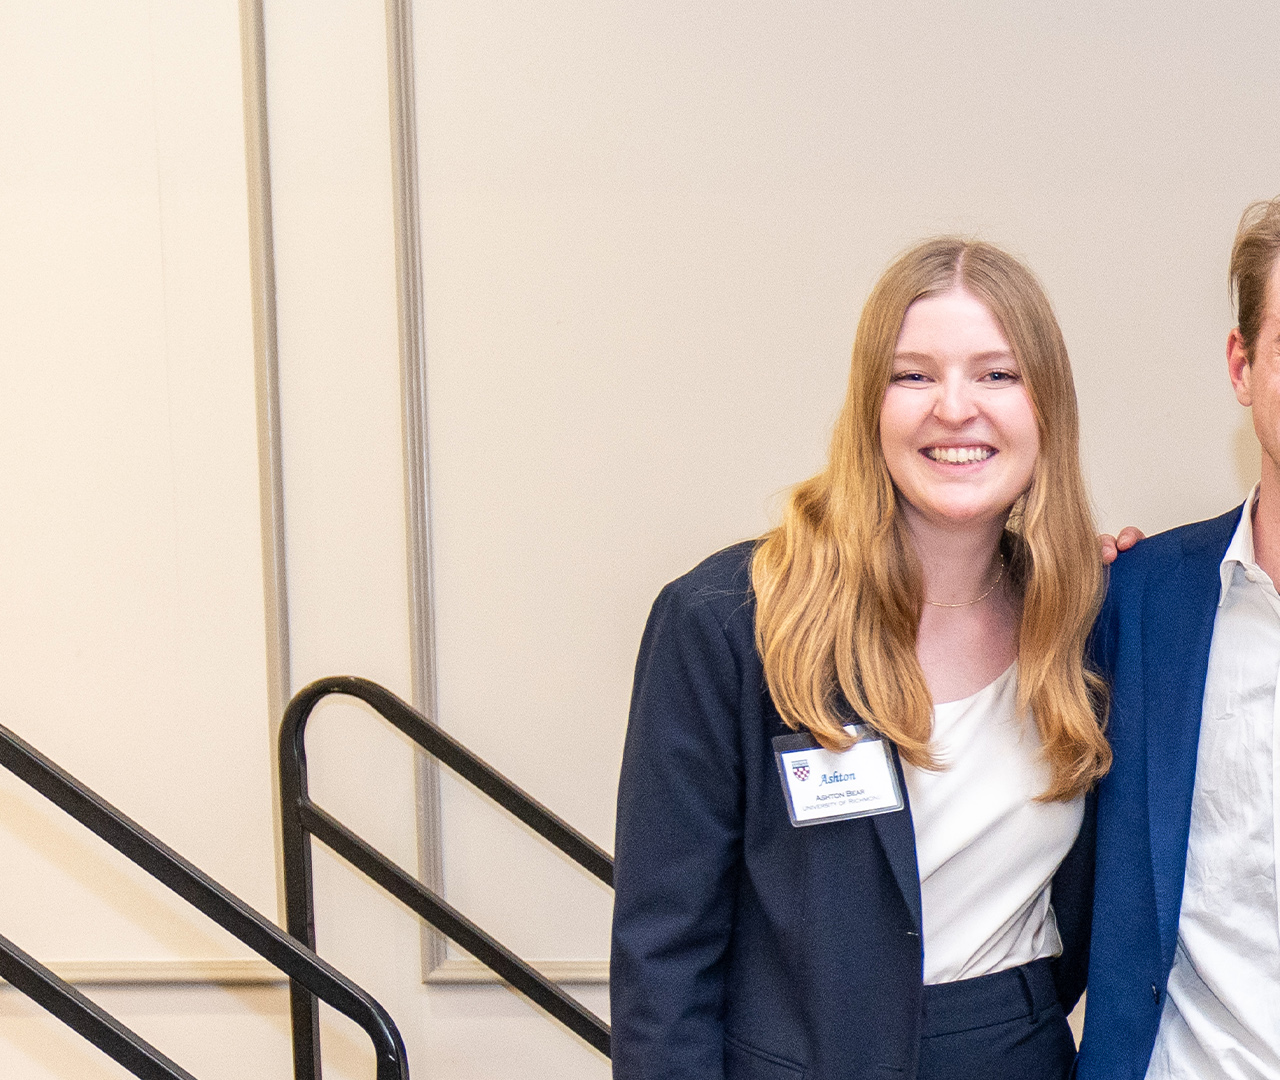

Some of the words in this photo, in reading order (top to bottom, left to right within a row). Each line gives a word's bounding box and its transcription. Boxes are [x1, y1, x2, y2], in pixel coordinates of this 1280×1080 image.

[818, 771, 857, 787] Ashton
[816, 792, 845, 801] ASHTON
[846, 789, 865, 797] BEAR
